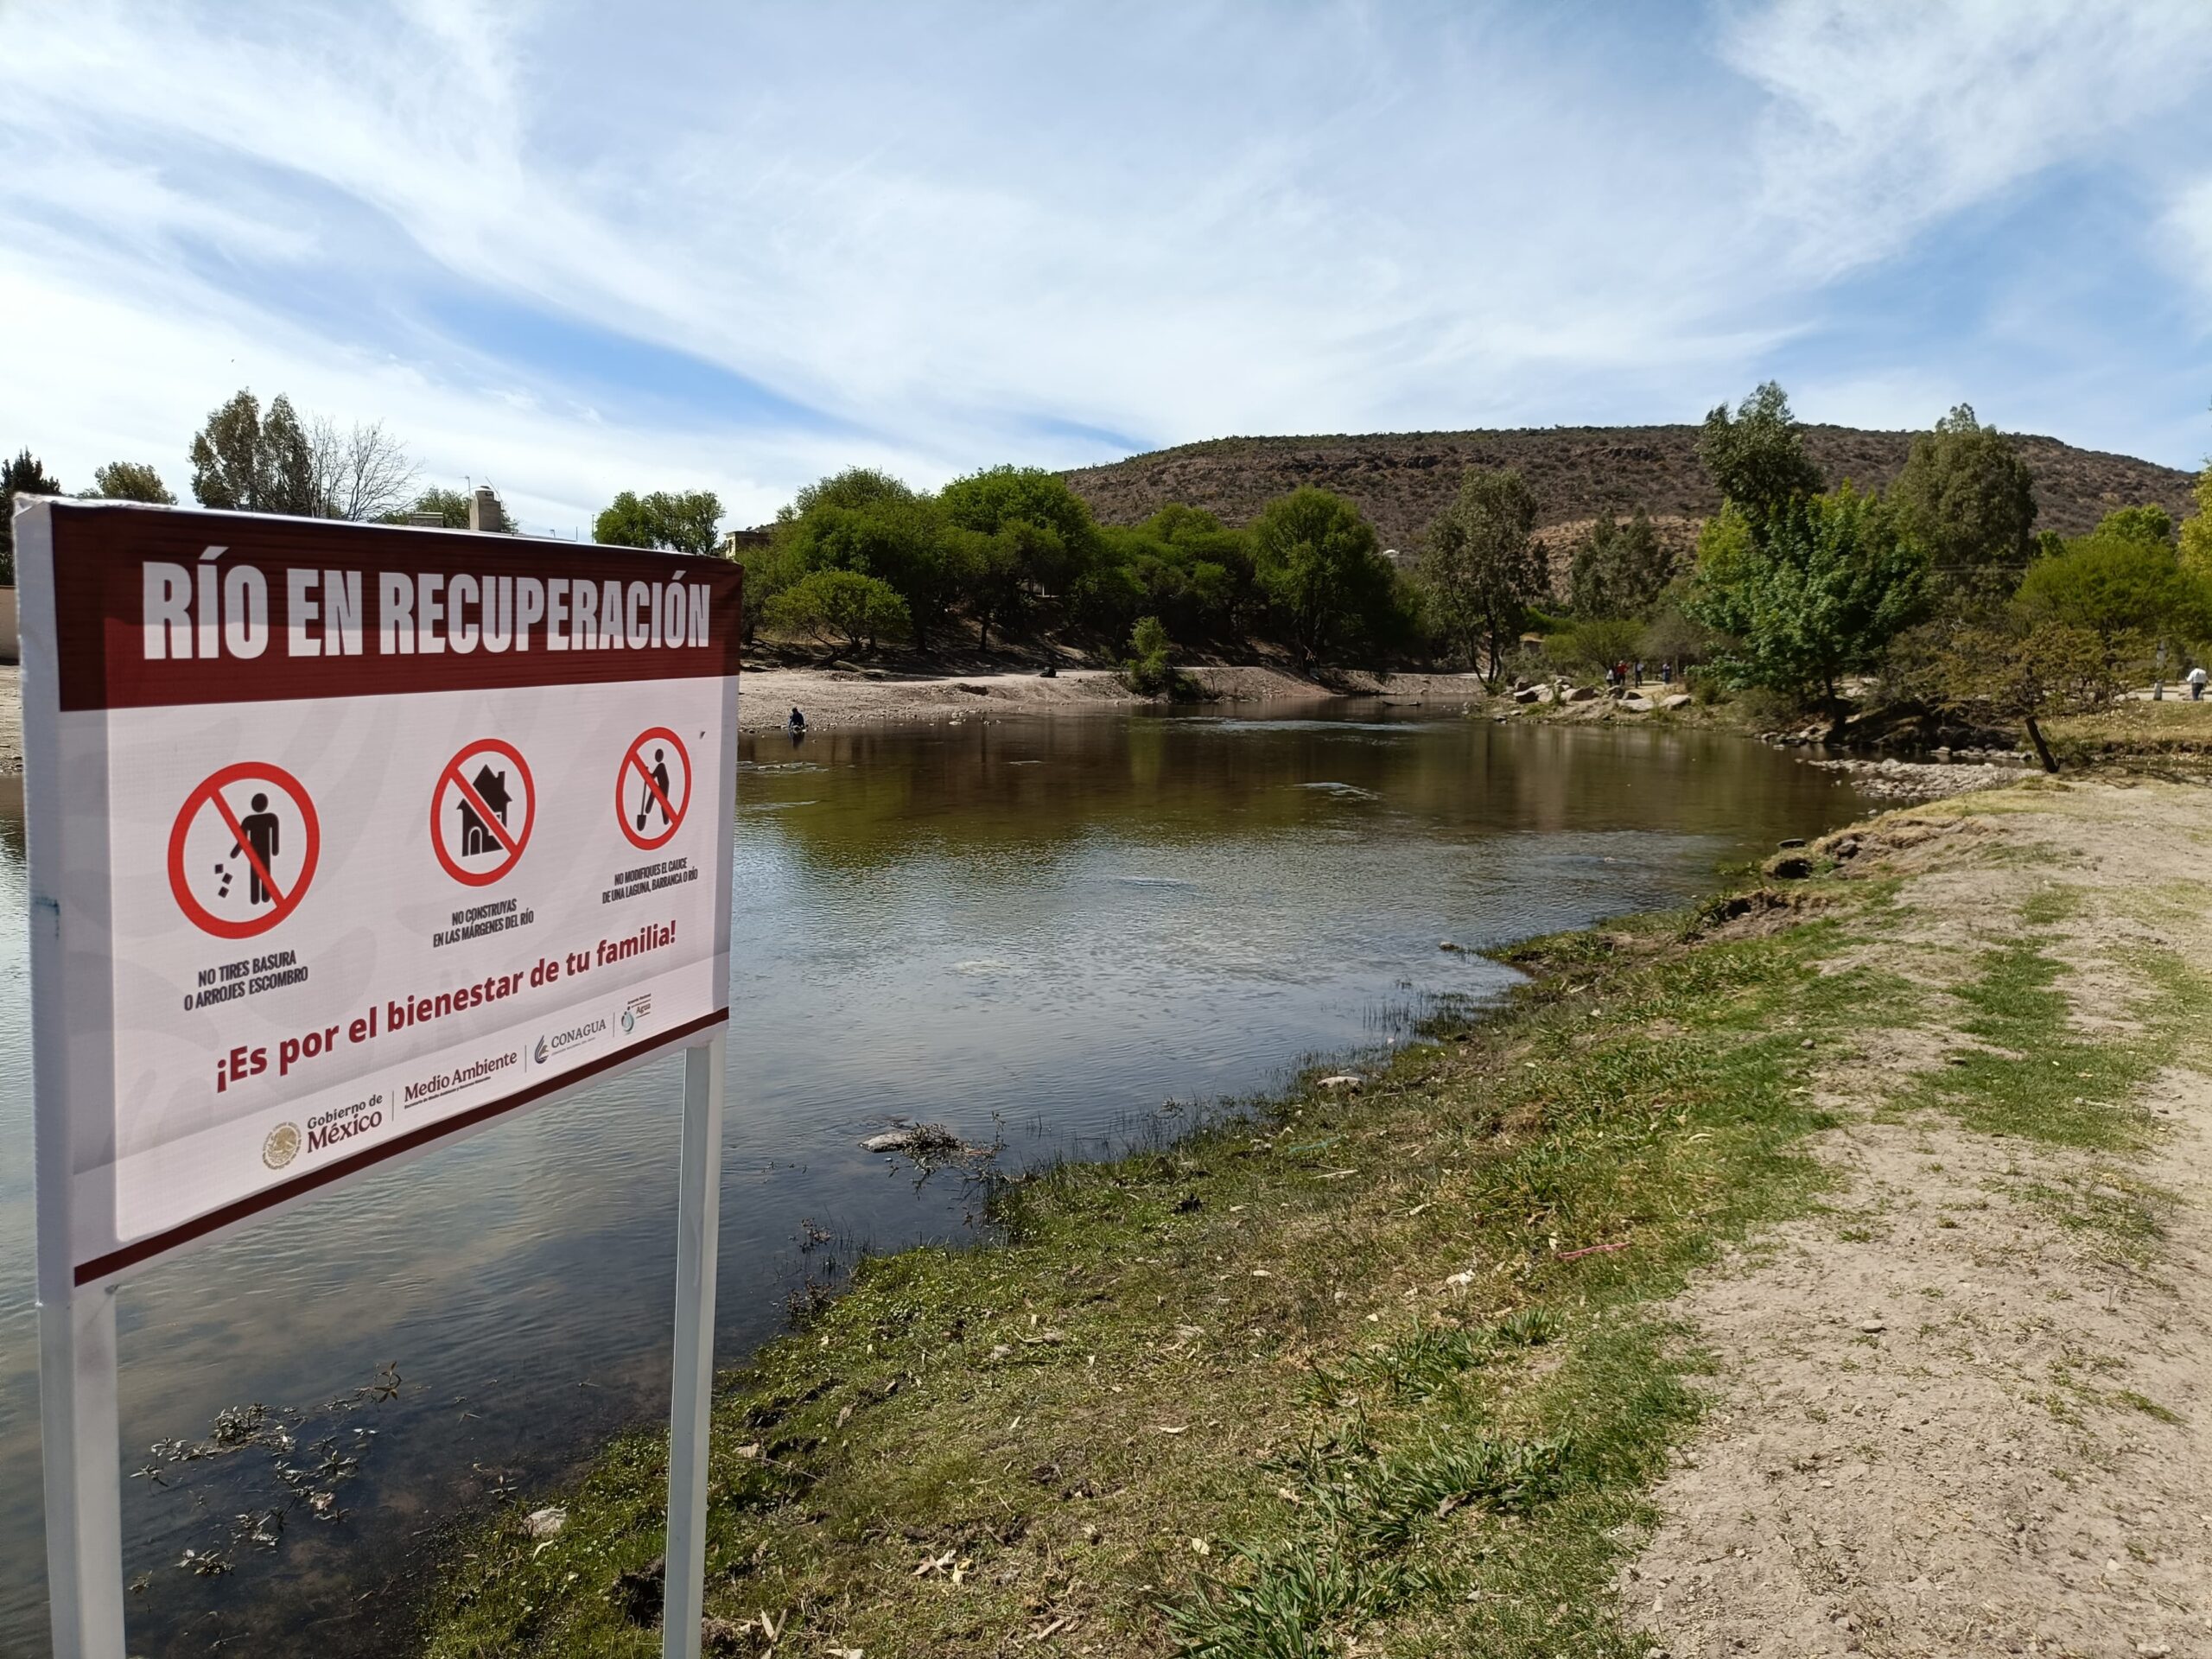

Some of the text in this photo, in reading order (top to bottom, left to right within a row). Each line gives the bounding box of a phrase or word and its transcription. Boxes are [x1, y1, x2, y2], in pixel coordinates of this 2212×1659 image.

[143, 545, 710, 660] RÍO EN RECUPERACIÓN
[602, 866, 698, 904] DE UNA LAGUNA, BARRANCA O RÍO
[614, 857, 687, 886] NO MODIFIQUES EL CAUCE
[433, 907, 534, 948] EN LAS MÁRGENES DEL RÍO
[452, 898, 518, 926] NO CONSTRUYAS
[199, 949, 296, 988] NO TIRES BASURA
[184, 966, 308, 1011] O ARROJES ESCOMBRO
[217, 919, 677, 1093] ¡Es por el bienestar de tu familia!
[636, 1002, 651, 1014] Agua
[551, 1019, 607, 1048] CONAGUA
[404, 1075, 450, 1102] Medio
[451, 1052, 518, 1085] Ambiente
[308, 1094, 383, 1130] Gobierno de
[308, 1111, 383, 1154] México
